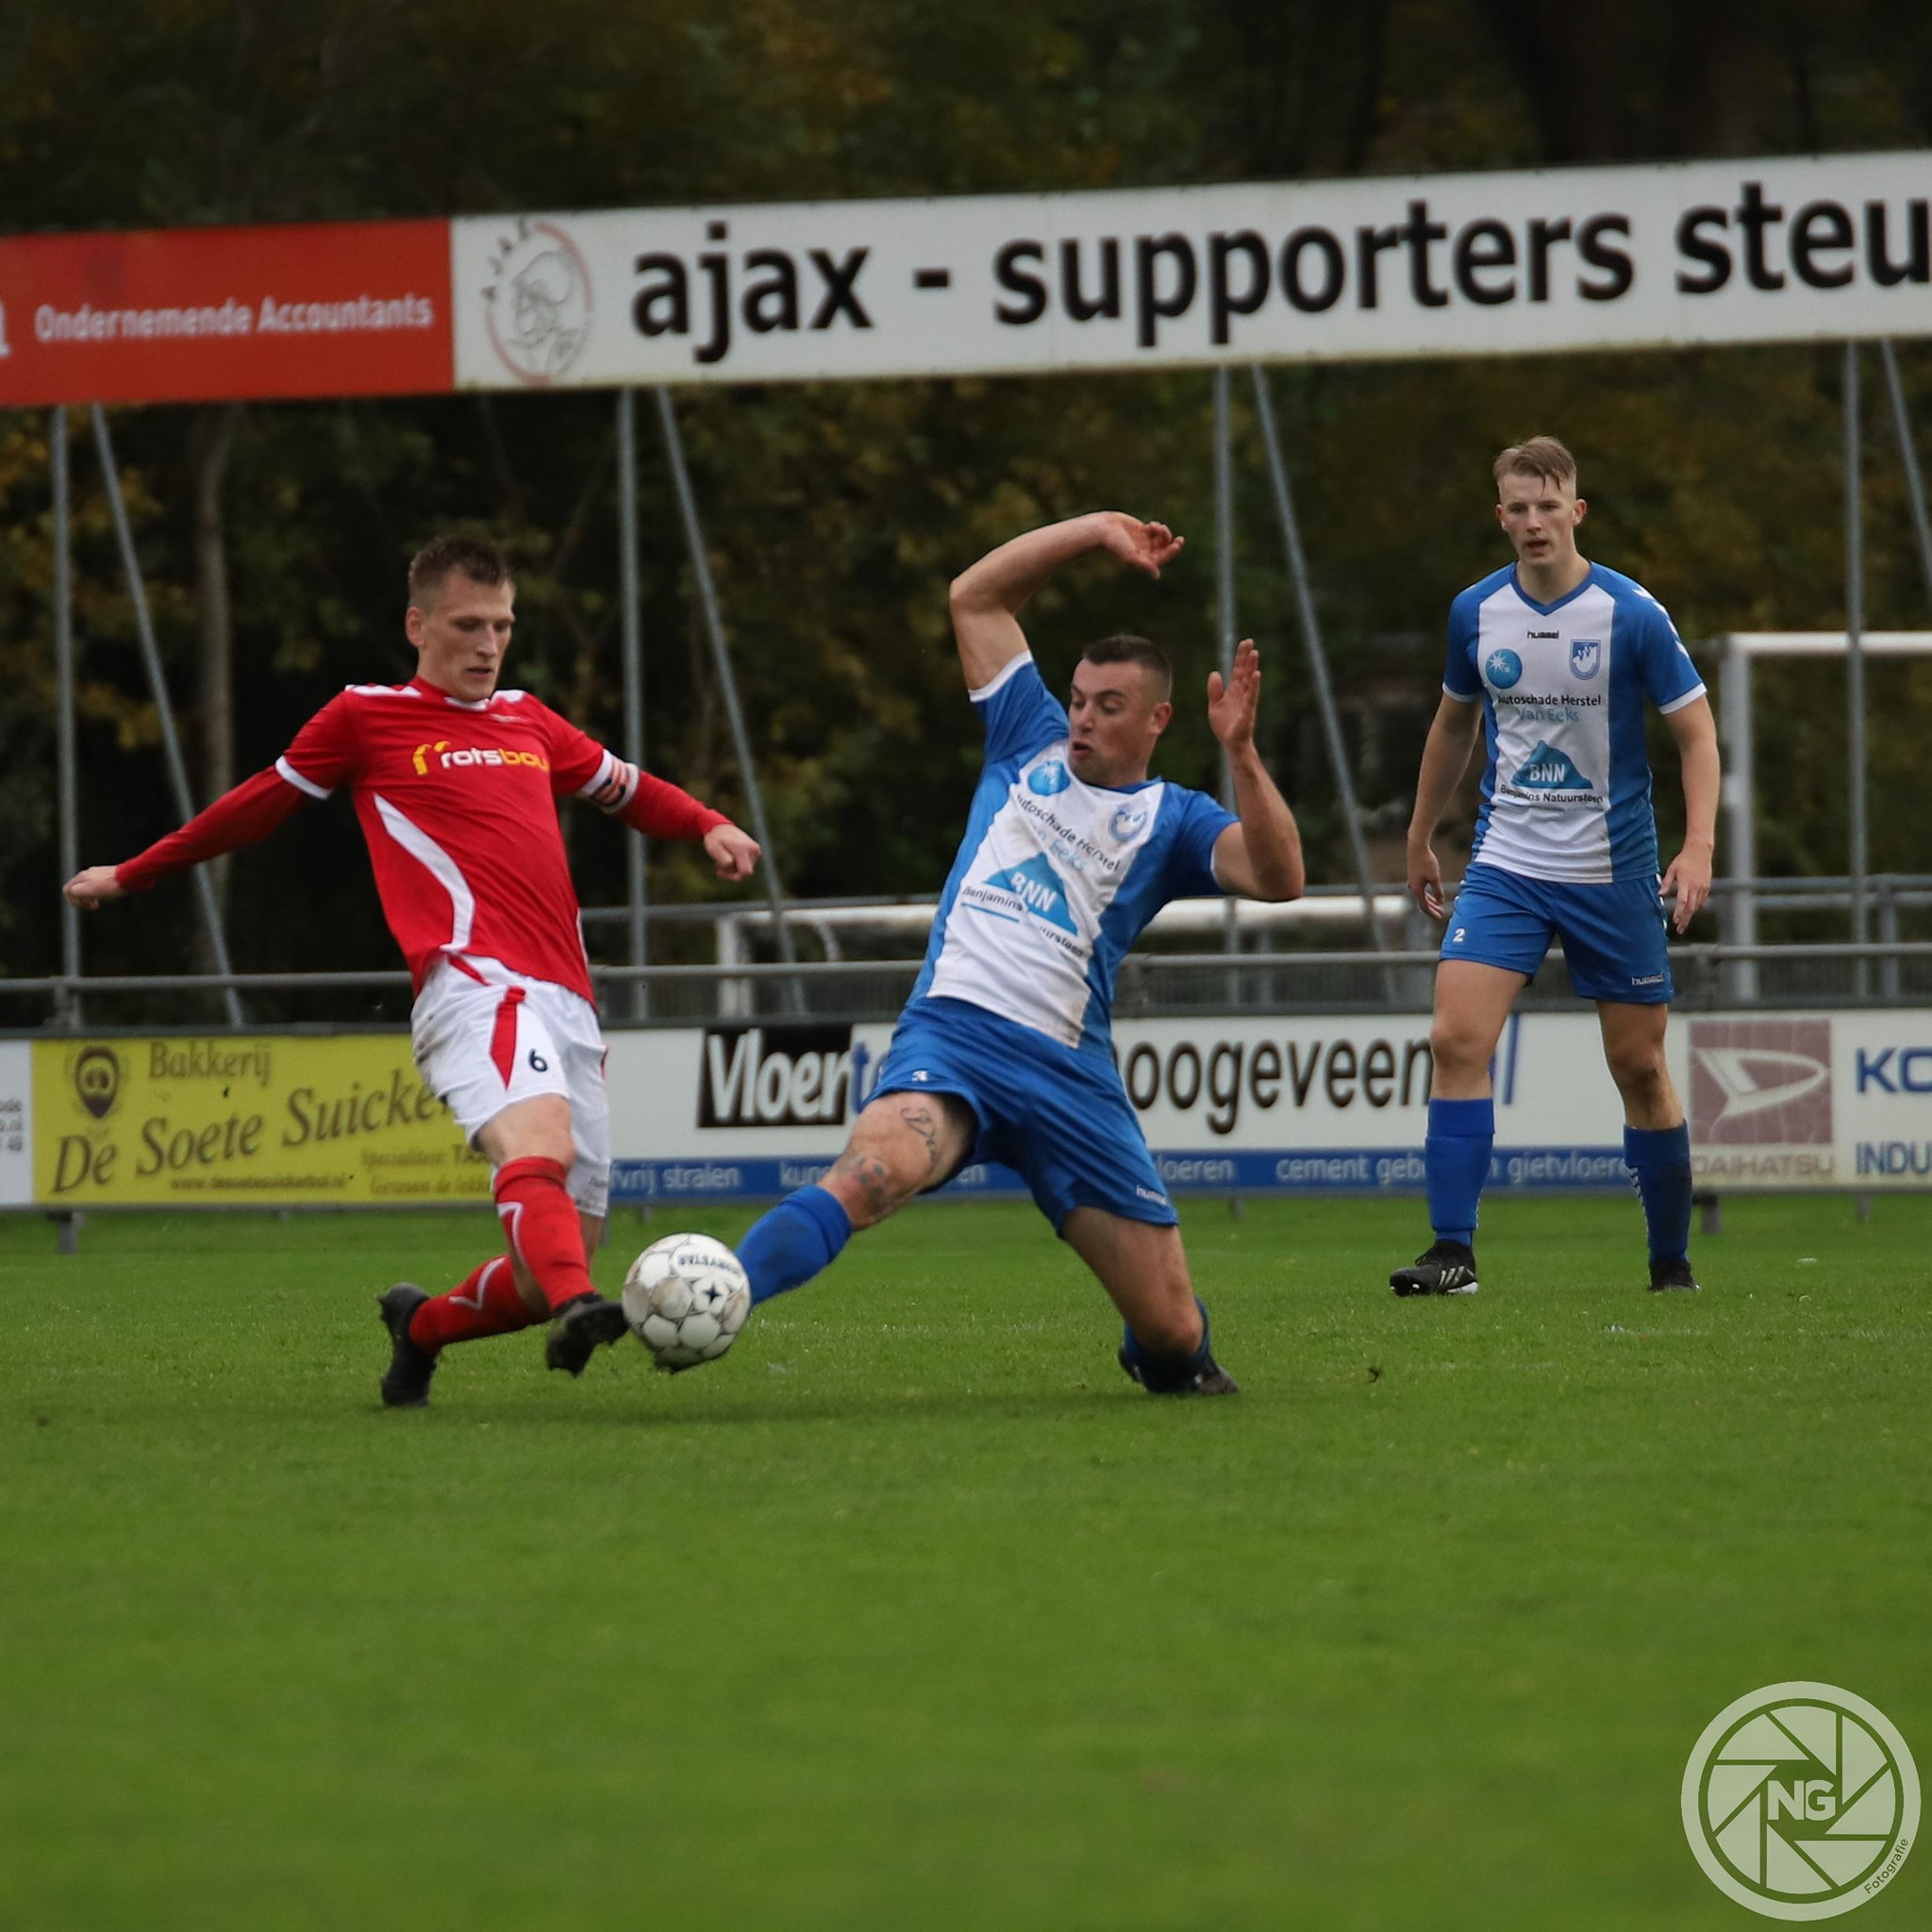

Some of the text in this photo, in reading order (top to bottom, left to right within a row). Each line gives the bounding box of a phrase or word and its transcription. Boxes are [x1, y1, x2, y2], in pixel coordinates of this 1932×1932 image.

[631, 222, 873, 364] ajax
[992, 199, 1636, 348] supporters
[35, 299, 252, 342] Ondernemende
[258, 291, 432, 334] Accountants
[1561, 694, 1602, 707] Herstel
[440, 746, 551, 774] rotsbou
[1529, 763, 1565, 783] BNN
[962, 885, 1024, 912] Benjamins
[1453, 928, 1465, 942] 2
[147, 1040, 272, 1087] Bakkerij
[528, 1049, 548, 1072] 6
[1116, 1036, 1433, 1135] oogeveen
[52, 1068, 447, 1192] De Soete Suicke
[663, 1161, 741, 1190] stralen
[1156, 1152, 1235, 1181] loeren
[1275, 1153, 1370, 1180] cement
[1508, 1150, 1629, 1184] gietvloere
